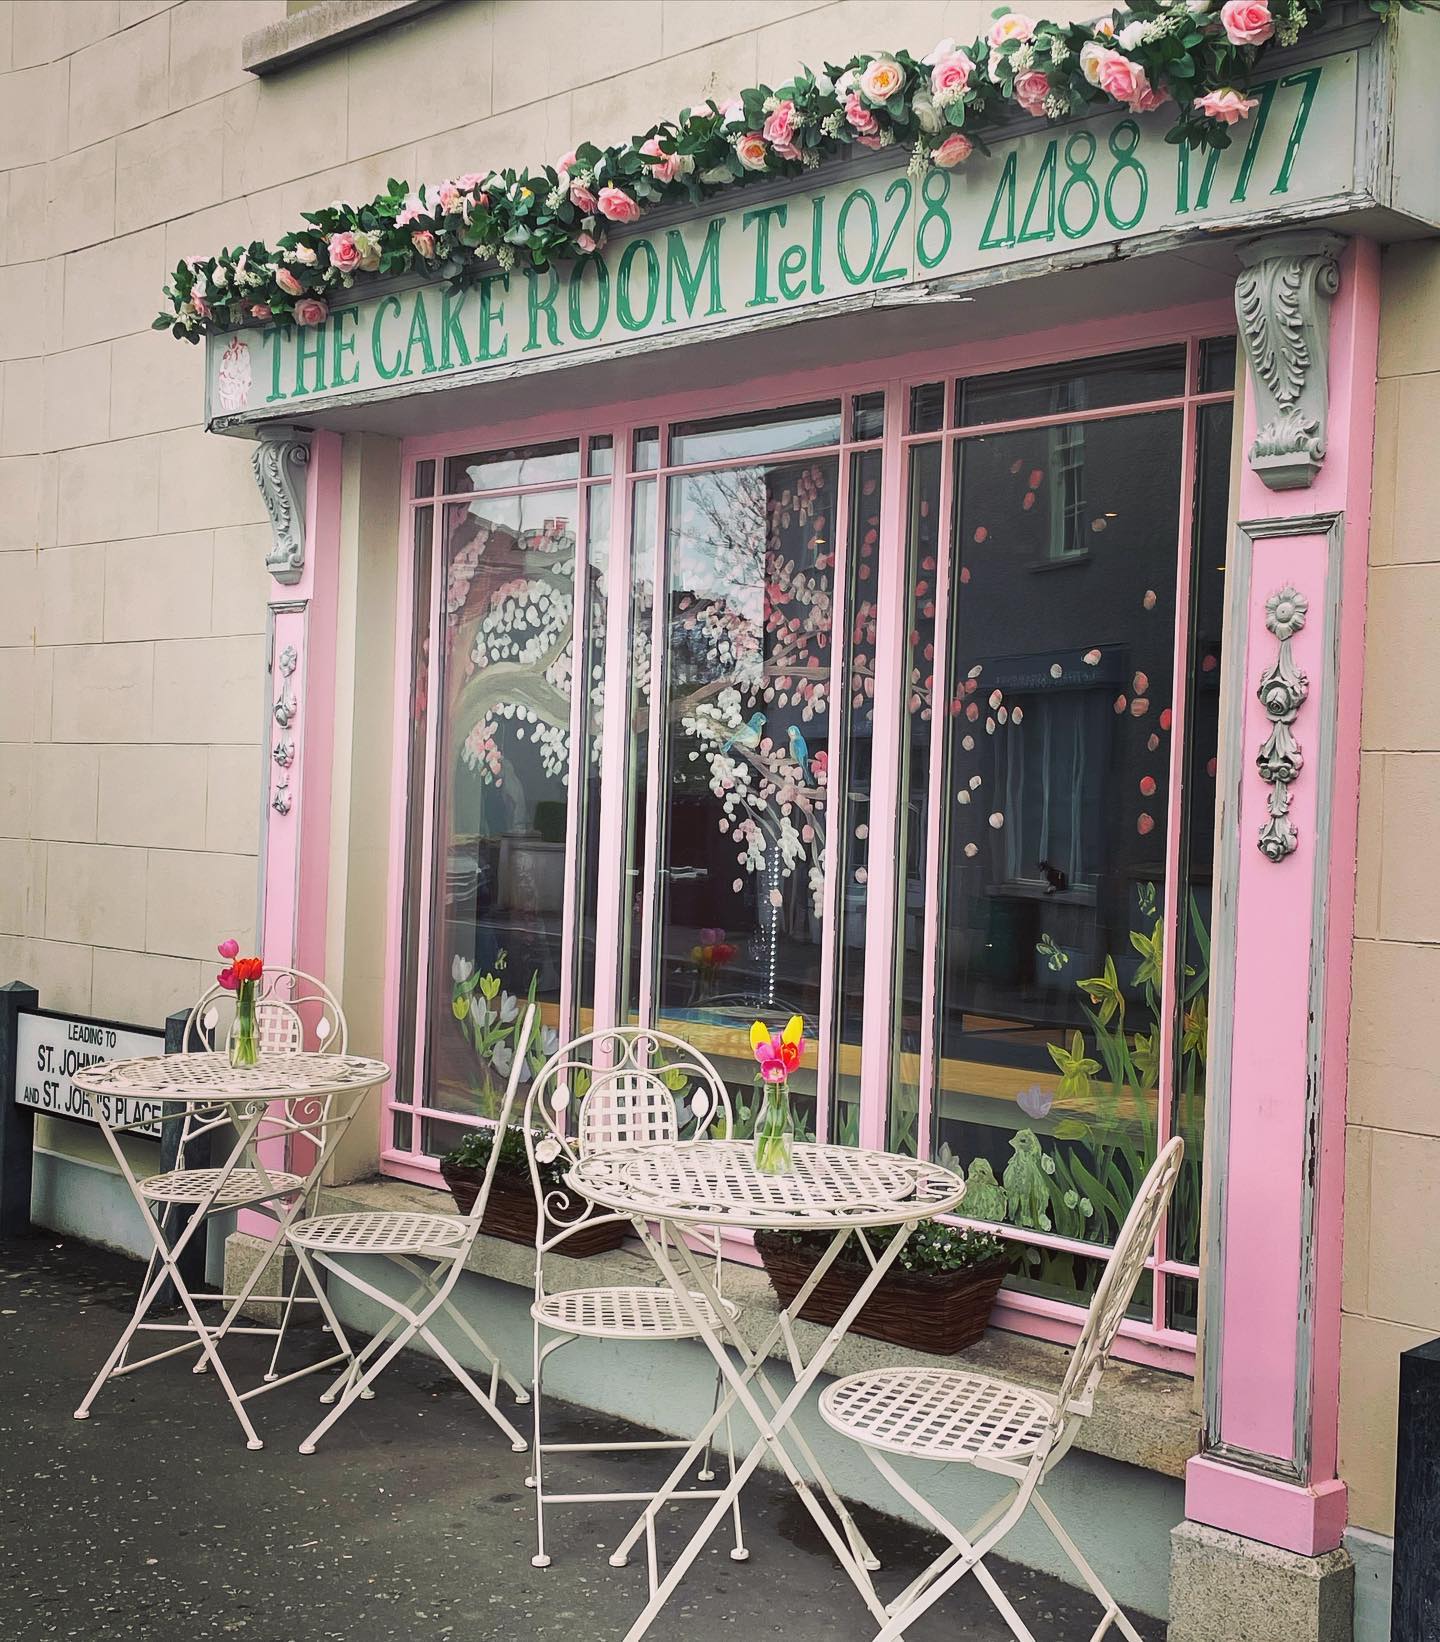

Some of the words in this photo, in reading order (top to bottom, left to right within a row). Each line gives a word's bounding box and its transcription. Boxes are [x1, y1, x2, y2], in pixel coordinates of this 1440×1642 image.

[263, 306, 360, 402] THE
[371, 272, 509, 380] CAKE
[522, 217, 727, 352] ROOM
[742, 195, 826, 308] Tel
[837, 168, 952, 285] 028
[979, 118, 1148, 251] 4488
[68, 1023, 103, 1046] LEADING
[106, 1030, 117, 1049] TO
[37, 1044, 55, 1073] ST.
[24, 1086, 39, 1104] AND
[43, 1080, 60, 1109] ST.
[116, 1097, 162, 1134] PLACE
